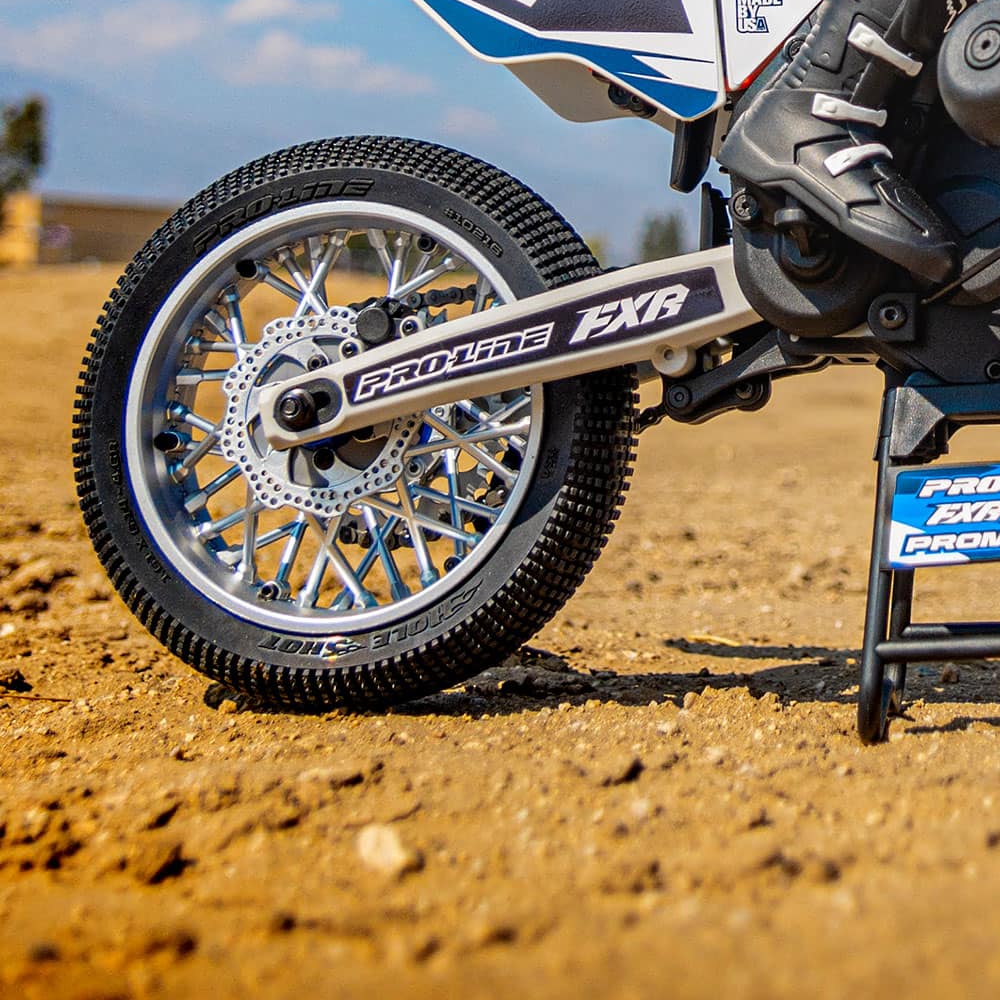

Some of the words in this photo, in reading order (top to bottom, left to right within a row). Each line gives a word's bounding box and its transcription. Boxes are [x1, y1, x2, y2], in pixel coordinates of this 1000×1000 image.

[736, 17, 769, 33] USA
[737, 5, 760, 18] BY
[568, 283, 691, 346] FXR
[352, 322, 556, 403] PRO-LINE
